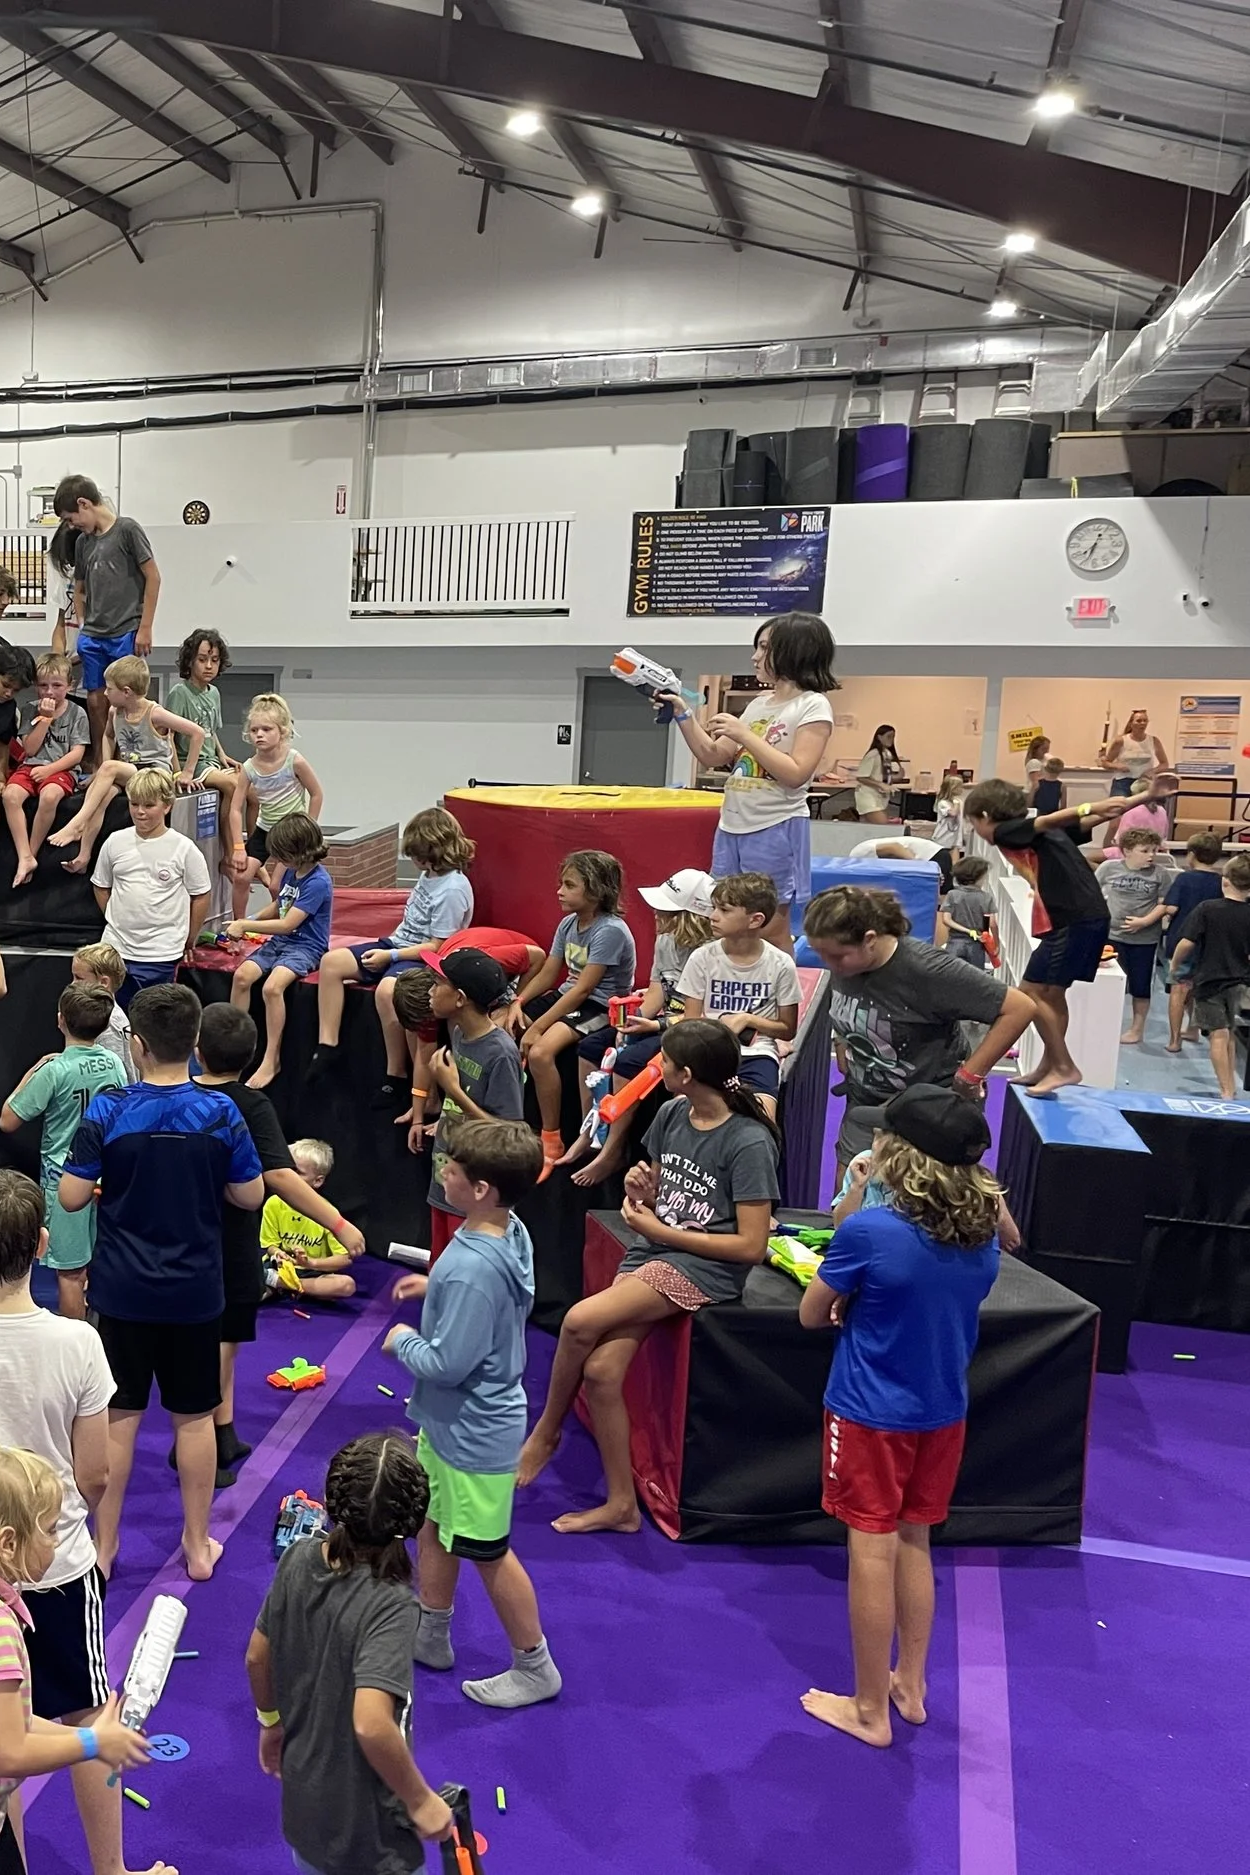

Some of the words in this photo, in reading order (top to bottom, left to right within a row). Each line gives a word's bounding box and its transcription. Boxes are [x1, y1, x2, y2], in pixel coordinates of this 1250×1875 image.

[800, 515, 824, 532] PARK
[636, 516, 654, 568] RULES
[634, 574, 650, 614] GYM
[1078, 598, 1107, 616] EXIT
[711, 979, 772, 997] EXPERT
[692, 1182, 708, 1196] DO
[702, 1172, 718, 1189] ME
[152, 1738, 181, 1756] 23
